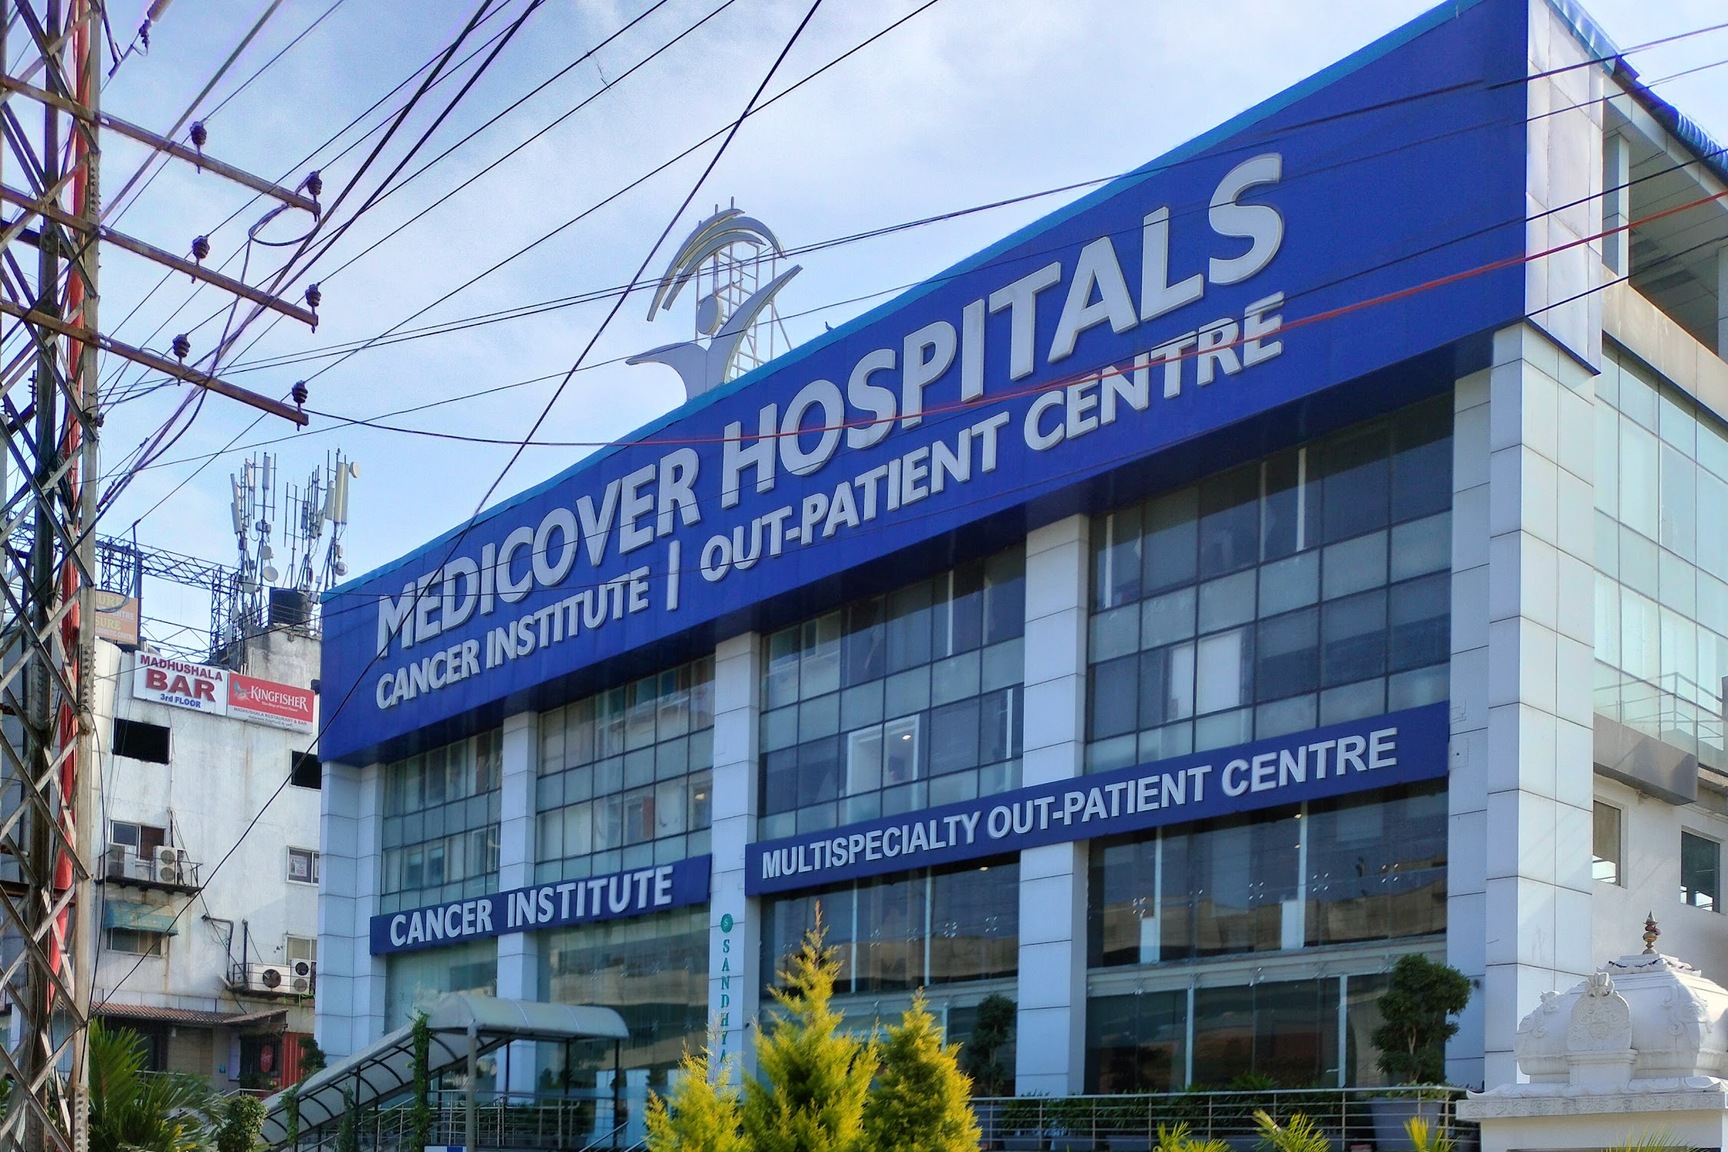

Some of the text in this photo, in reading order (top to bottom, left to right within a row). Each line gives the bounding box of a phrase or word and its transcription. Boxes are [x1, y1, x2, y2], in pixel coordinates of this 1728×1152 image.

[376, 153, 1284, 658] MEDICOVER HOSPITALS
[376, 638, 480, 710] CANCER
[486, 565, 649, 669] INSTITUTE
[700, 412, 1010, 583] OUT-PATIENT
[1023, 291, 1284, 451] CENTRE
[140, 654, 223, 682] MADHUSHALA
[145, 668, 217, 702] BAR
[160, 693, 201, 709] 3rd FLOOR
[250, 685, 309, 712] KINGFISHER
[761, 727, 1398, 880] MULTISPECIALTY OUT-PATIENT CENTRE
[389, 864, 675, 947] CANCER INSTITUTE
